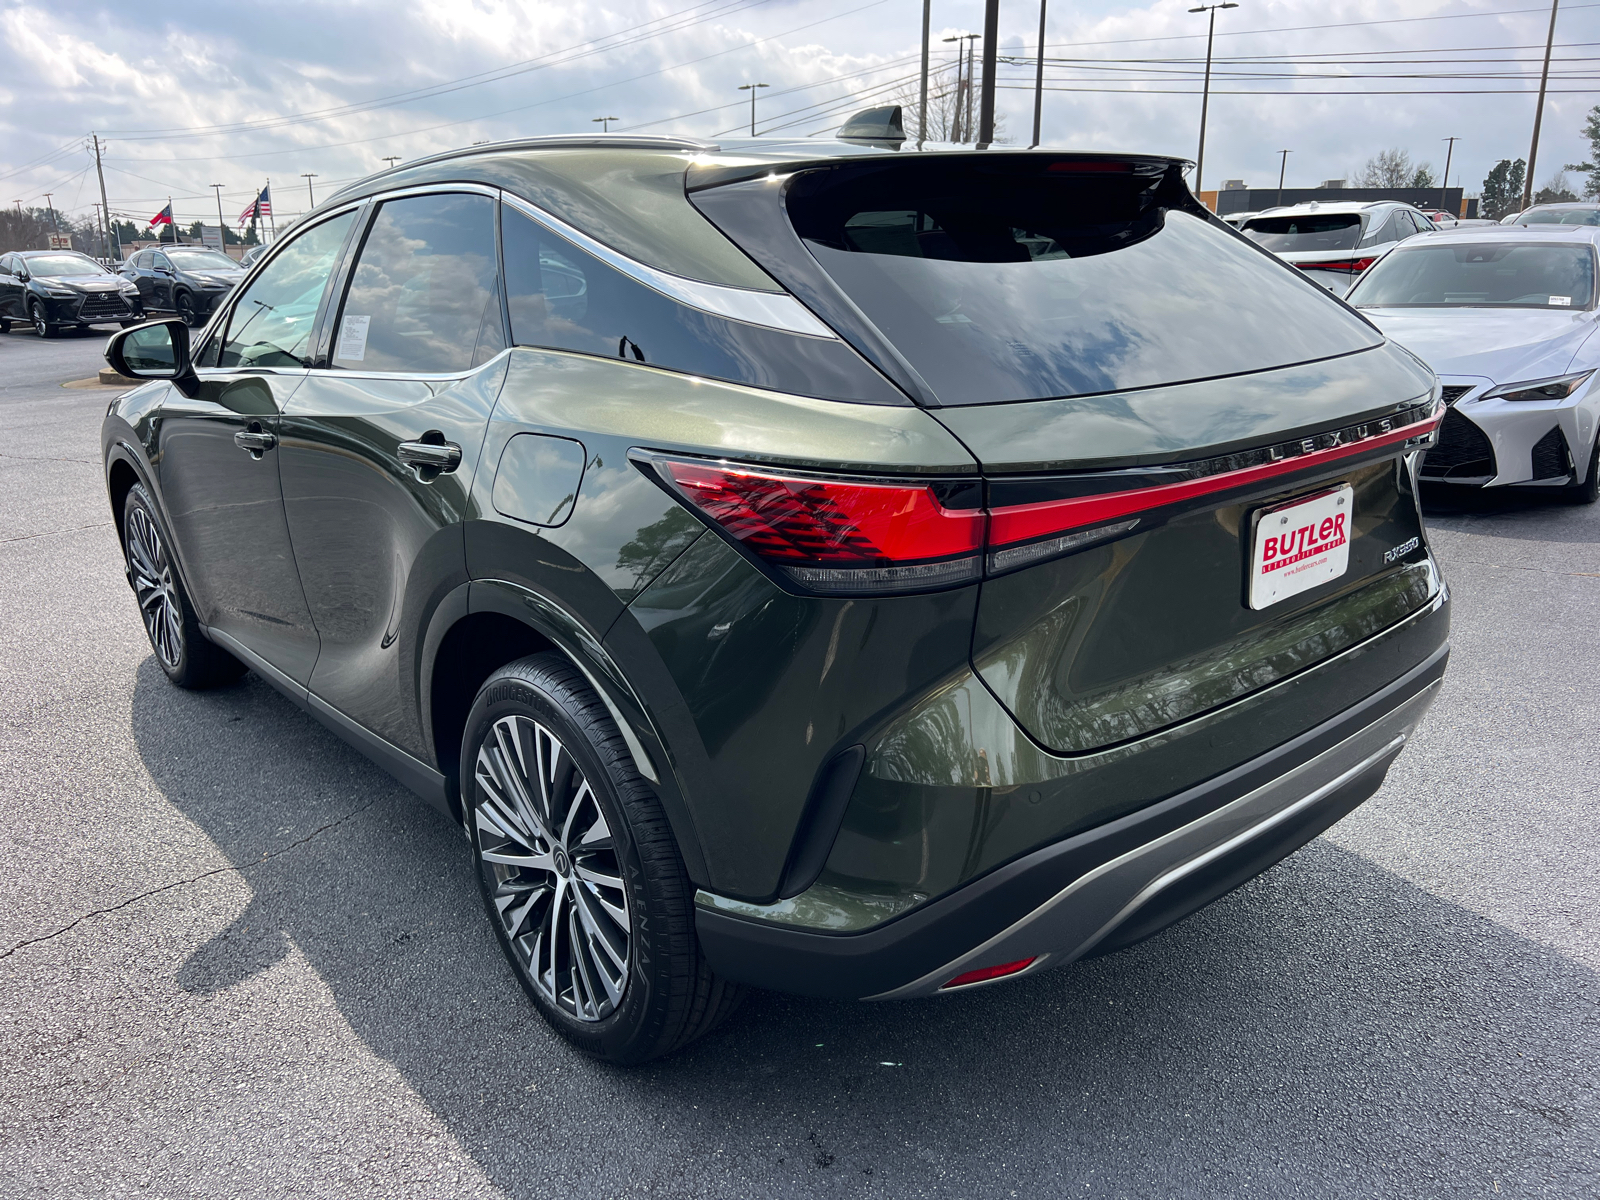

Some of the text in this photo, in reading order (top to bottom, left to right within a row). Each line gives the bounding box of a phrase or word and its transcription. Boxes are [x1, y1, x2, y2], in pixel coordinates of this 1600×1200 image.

[1270, 419, 1392, 461] LEXUS
[1262, 537, 1346, 574] AUTOMOTIVE GROUP
[1284, 557, 1328, 577] www.butlercars.com
[485, 685, 560, 726] BRIDGESTONE
[627, 864, 652, 965] ALENZA
